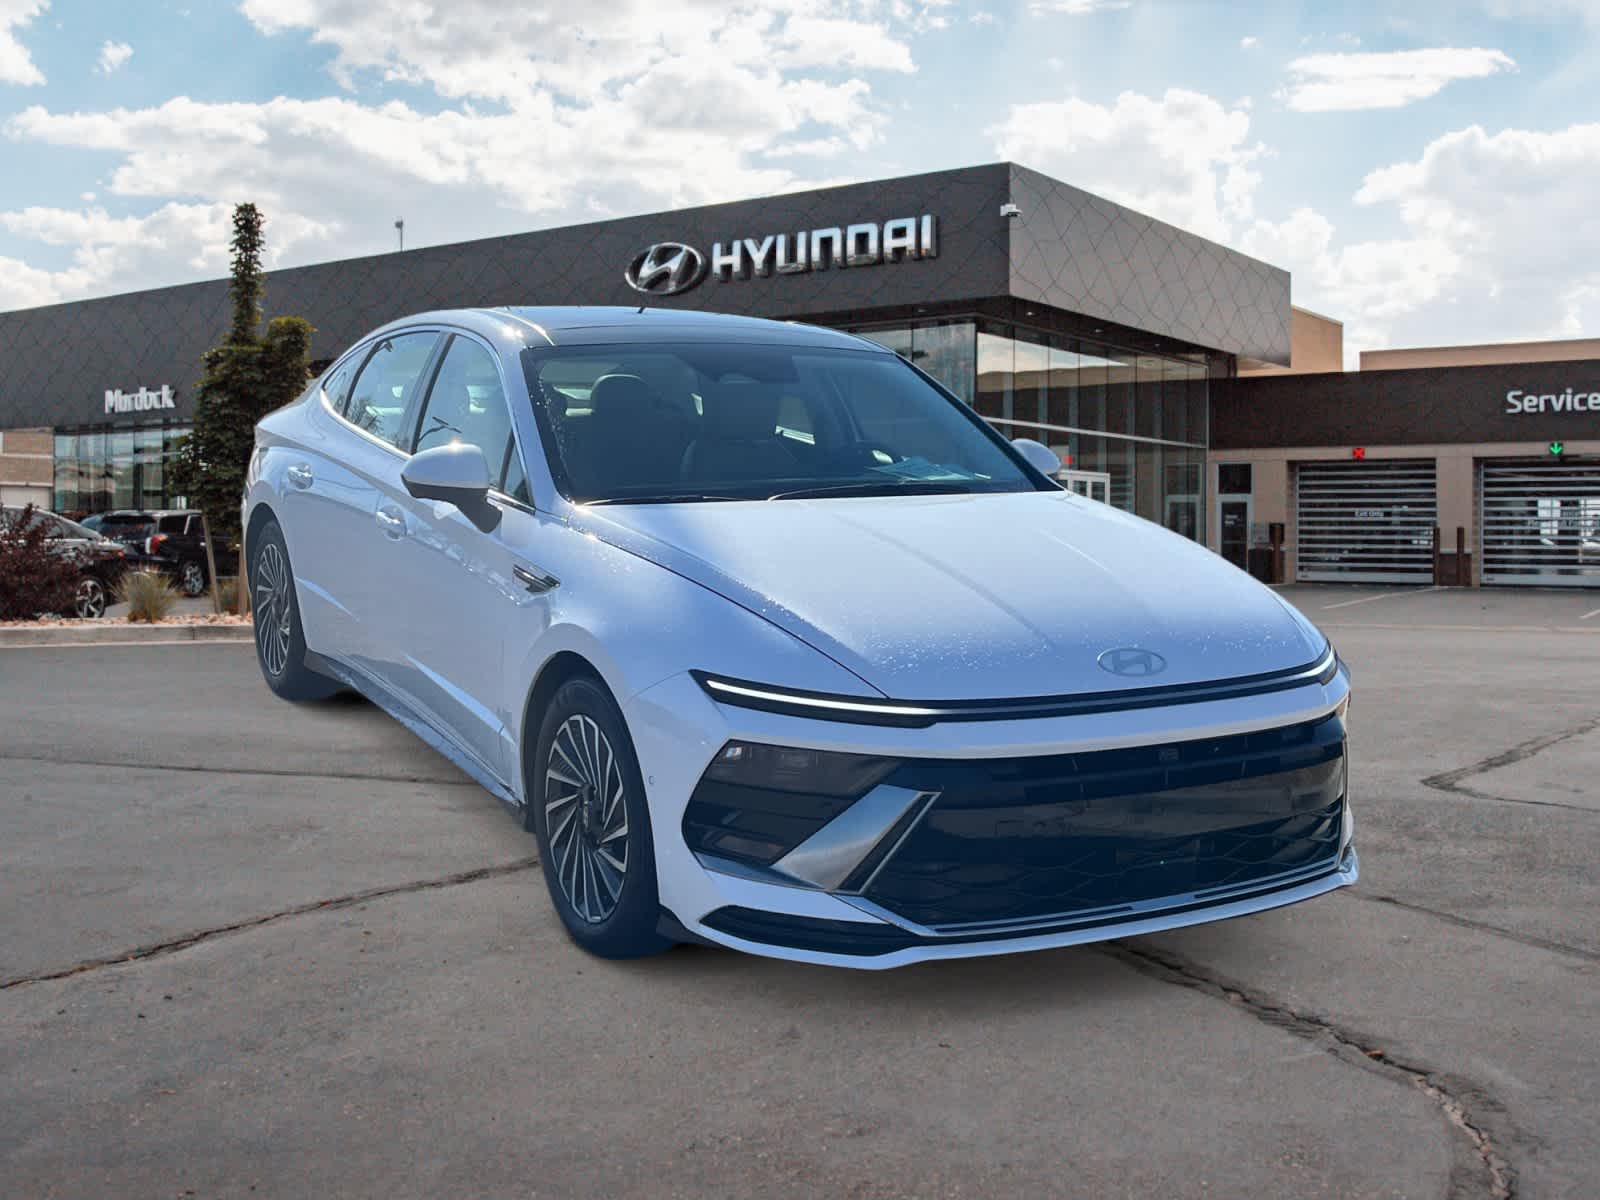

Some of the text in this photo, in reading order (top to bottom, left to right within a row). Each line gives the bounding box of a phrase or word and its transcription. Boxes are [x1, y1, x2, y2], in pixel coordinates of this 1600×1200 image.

[711, 213, 937, 282] HYUNDAI
[104, 384, 176, 414] Murdock
[1505, 387, 1600, 414] Service
